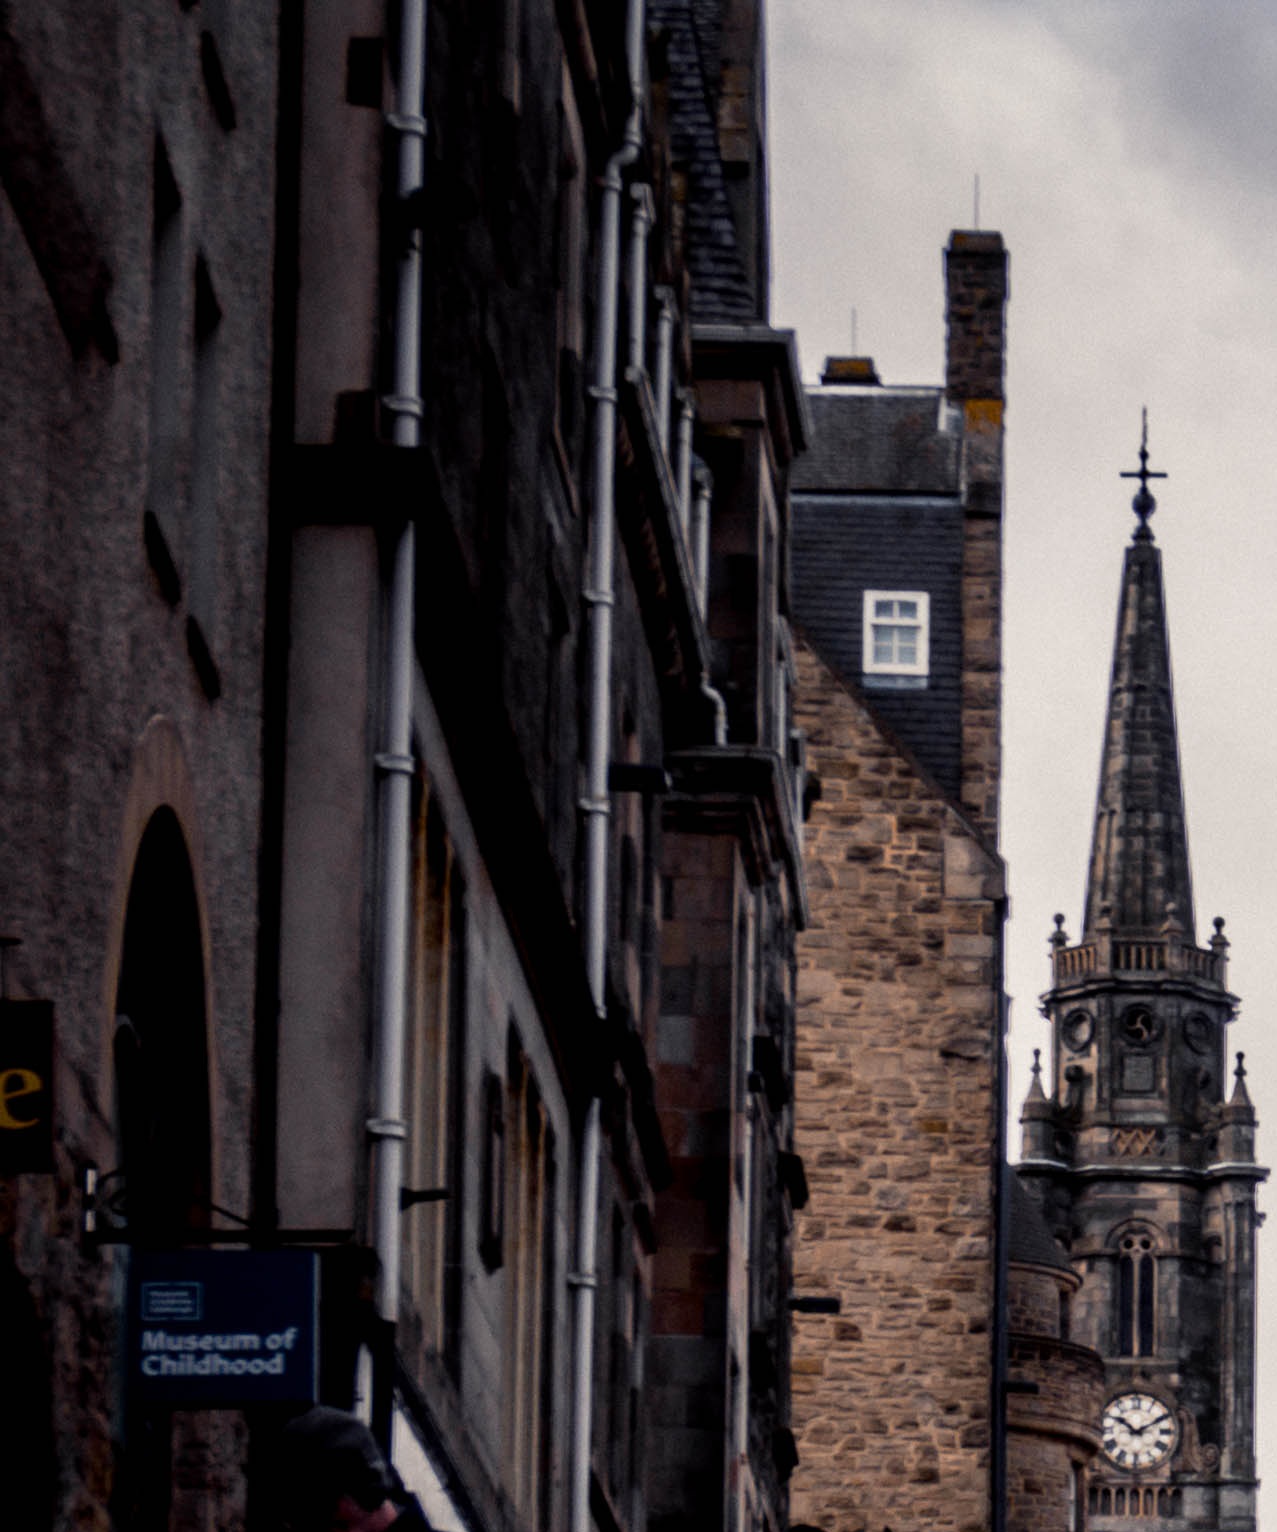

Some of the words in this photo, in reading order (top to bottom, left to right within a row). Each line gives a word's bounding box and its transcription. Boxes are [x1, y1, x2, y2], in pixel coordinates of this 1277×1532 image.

[141, 1329, 262, 1351] Museum
[265, 1325, 298, 1351] of
[141, 1353, 286, 1376] Childhood
